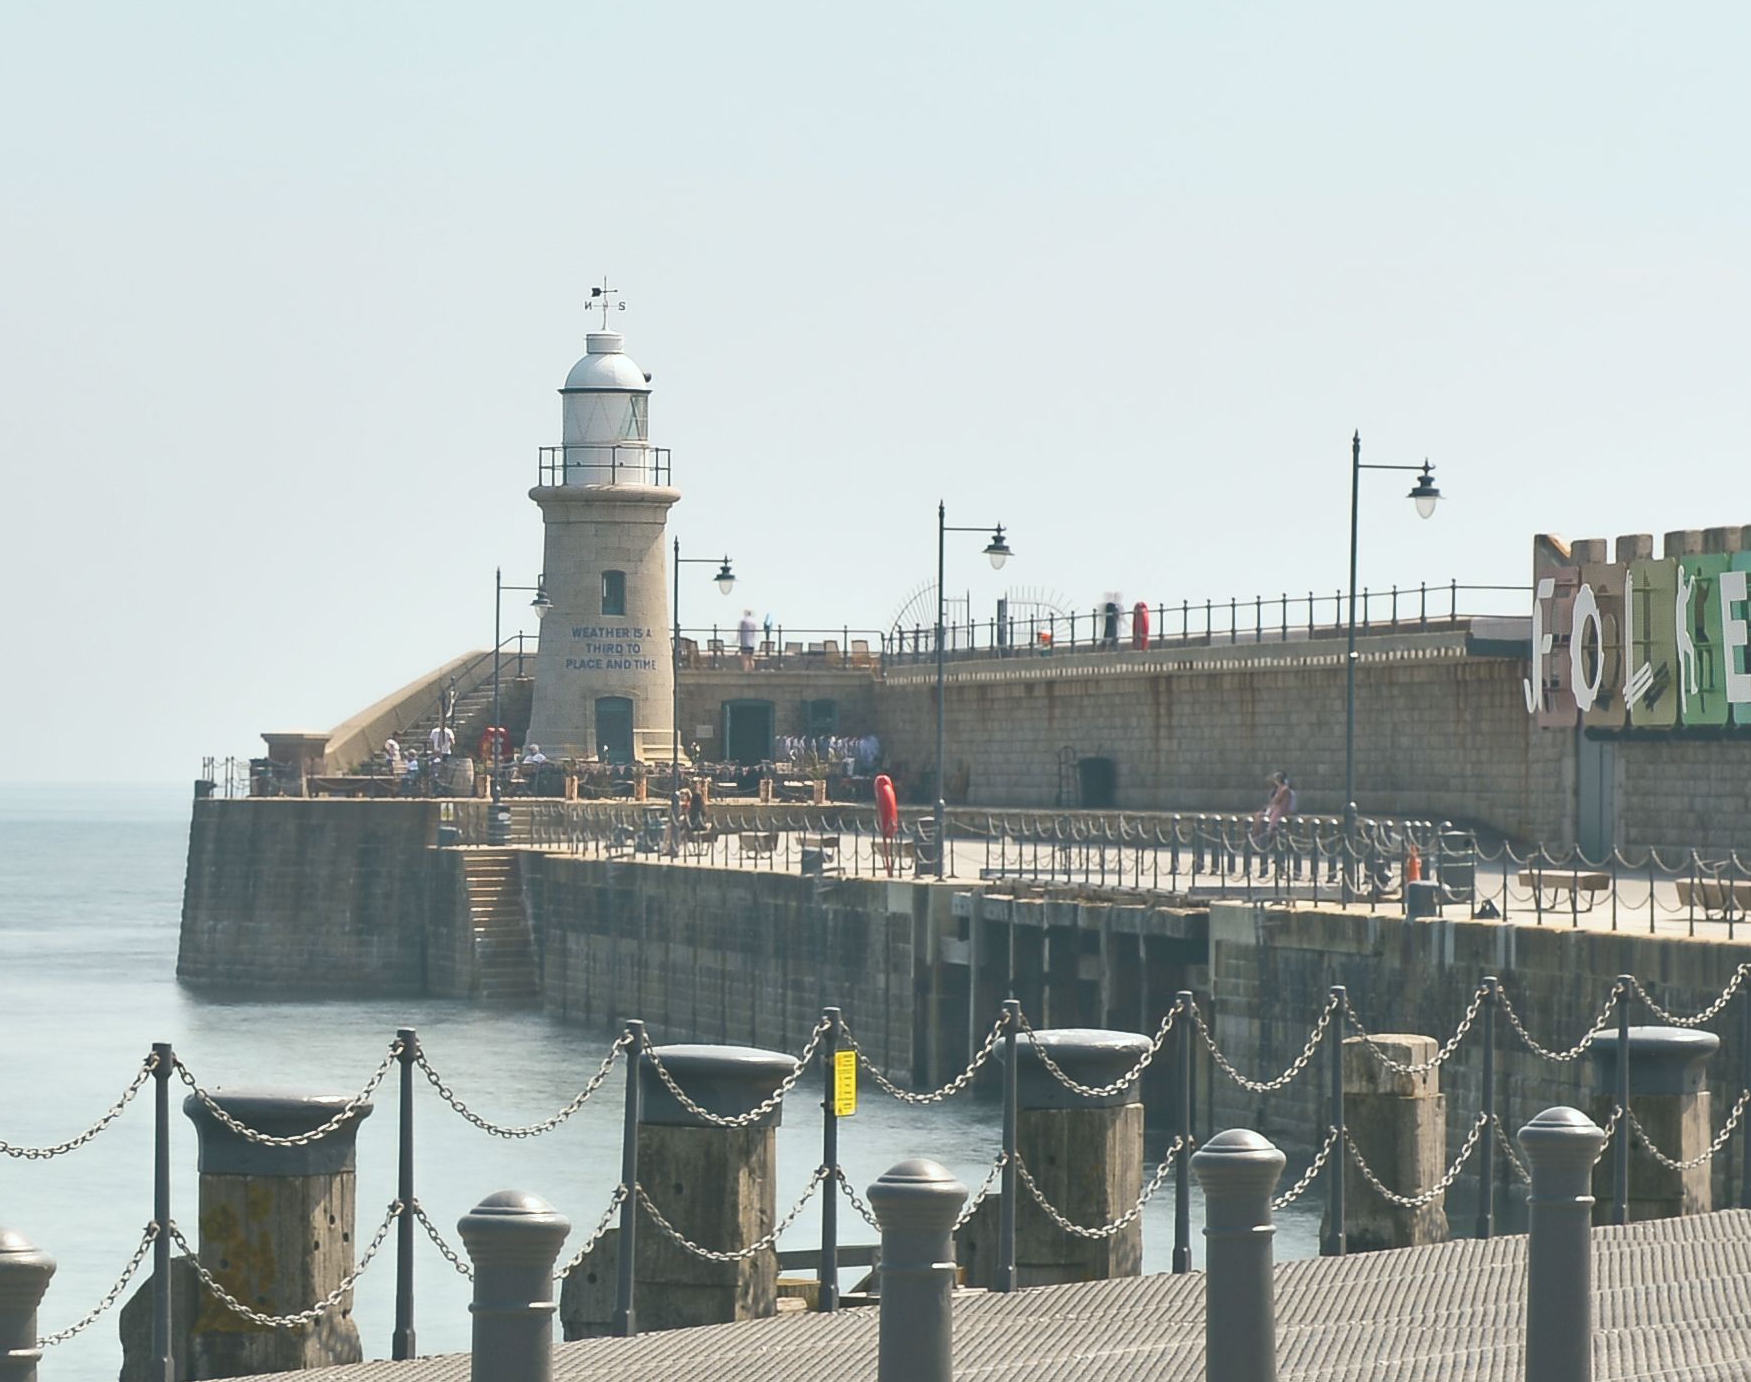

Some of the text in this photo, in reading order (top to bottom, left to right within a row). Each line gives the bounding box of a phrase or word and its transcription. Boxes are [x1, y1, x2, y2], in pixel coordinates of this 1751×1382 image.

[572, 627, 630, 638] WEATHER
[633, 627, 643, 638] IS
[586, 643, 641, 654] THIRD TO
[566, 659, 657, 670] PLACE AND TIME
